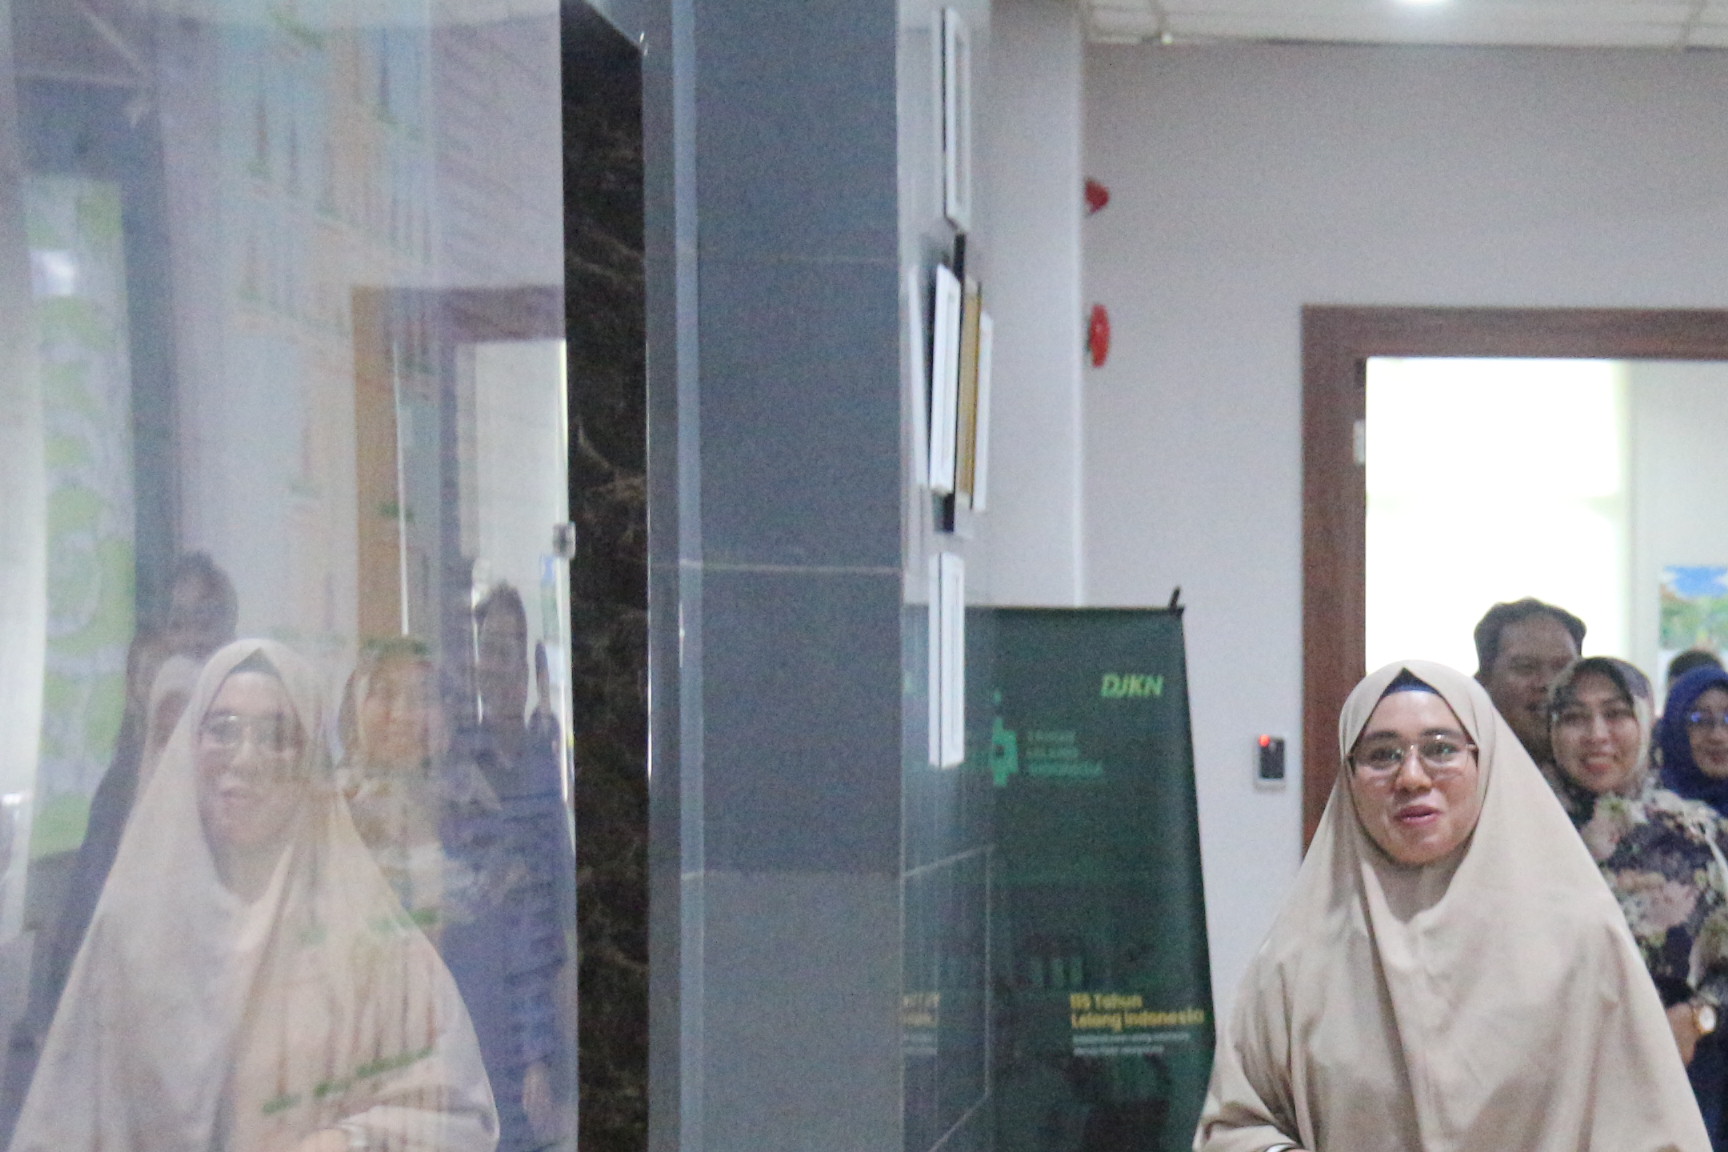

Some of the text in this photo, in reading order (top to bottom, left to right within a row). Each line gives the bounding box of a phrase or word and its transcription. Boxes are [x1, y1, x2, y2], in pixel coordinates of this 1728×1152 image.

[1101, 673, 1164, 697] DJKN
[1094, 993, 1143, 1010] Tahun
[1071, 1009, 1205, 1032] Lelang Indonesia
